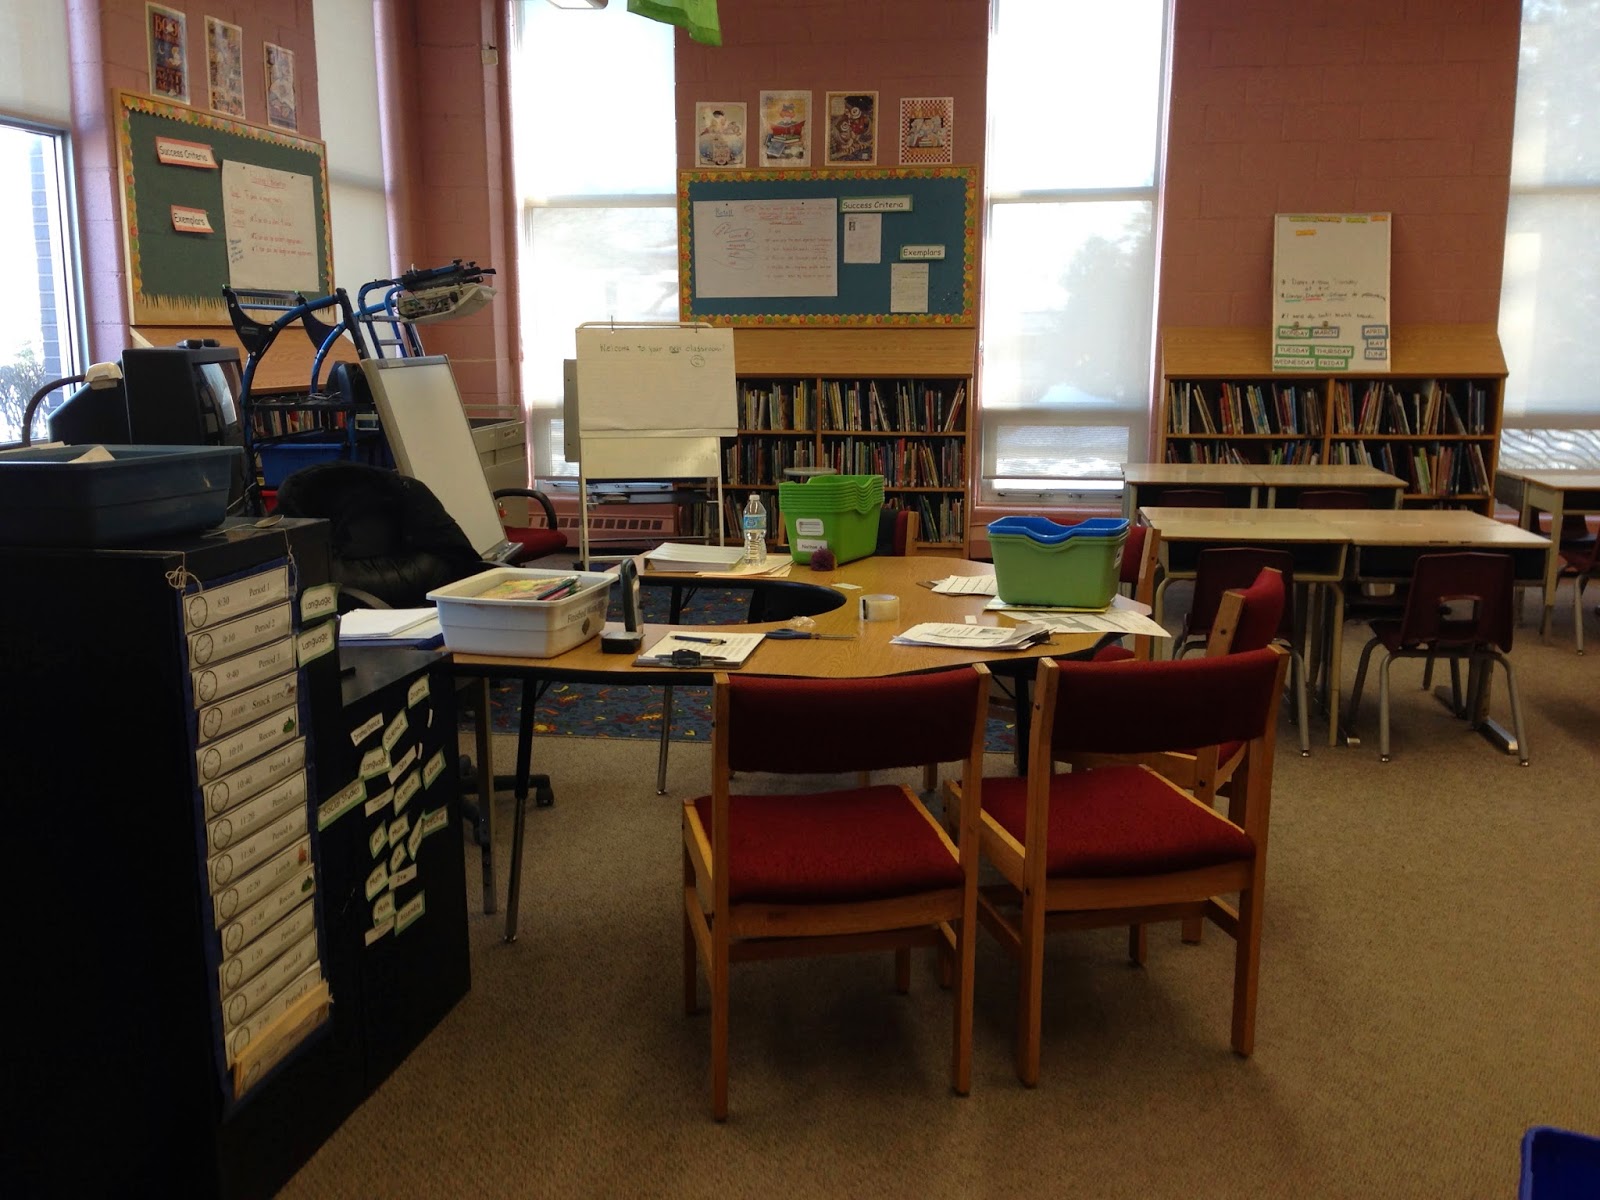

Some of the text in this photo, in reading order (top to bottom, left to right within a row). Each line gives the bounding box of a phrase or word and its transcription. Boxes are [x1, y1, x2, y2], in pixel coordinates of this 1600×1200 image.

[159, 145, 208, 162] Success Criteria
[843, 201, 904, 210] Success Criteria
[174, 212, 205, 227] Exemplars
[903, 248, 942, 259] Exemplars
[1280, 329, 1309, 338] MONDAY
[1313, 328, 1337, 336] MARCH
[1274, 358, 1315, 366] WEDNESDAY
[1319, 359, 1344, 367] FRIDAY
[249, 585, 266, 597] Period
[305, 595, 332, 610] Language
[254, 621, 272, 634] Period
[301, 632, 329, 650] Language
[258, 656, 276, 669] Period
[252, 695, 271, 709] Snack
[258, 727, 277, 742] Recess
[385, 719, 404, 744] Science
[269, 759, 286, 773] Period
[363, 755, 387, 772] Language
[272, 793, 288, 808] Period
[323, 799, 341, 817] Social
[342, 786, 360, 803] Studies
[272, 826, 288, 842] Period
